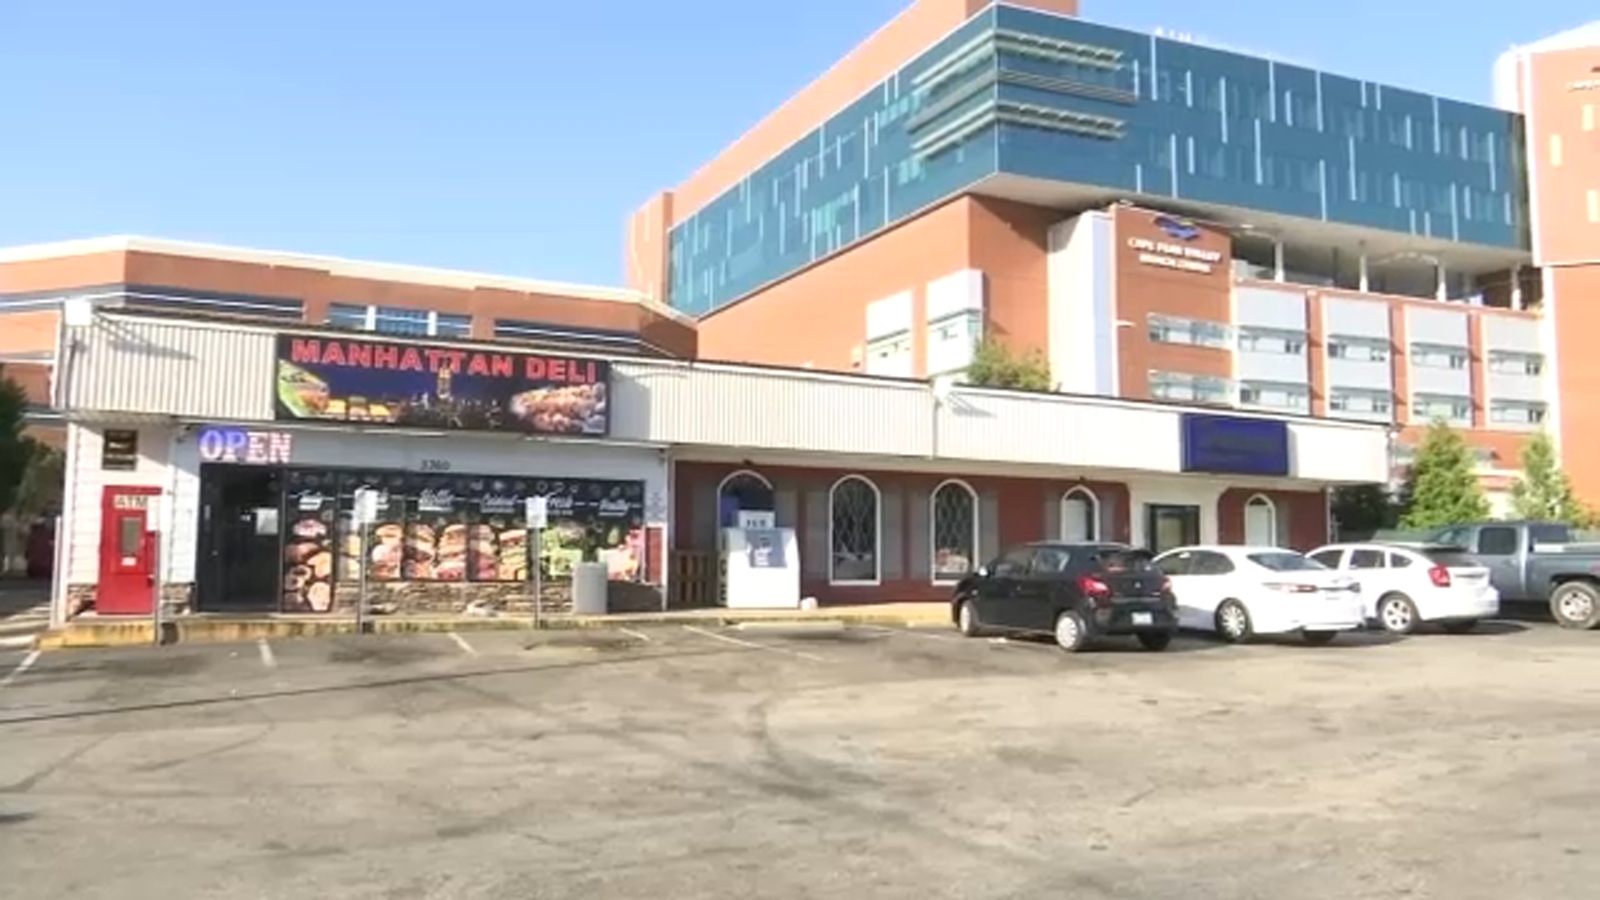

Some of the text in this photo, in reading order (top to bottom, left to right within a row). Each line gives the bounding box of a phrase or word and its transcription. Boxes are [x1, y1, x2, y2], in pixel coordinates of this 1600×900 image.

[291, 339, 596, 383] MANHATTAN DELI
[200, 429, 292, 464] OPEN
[114, 496, 149, 509] ATM
